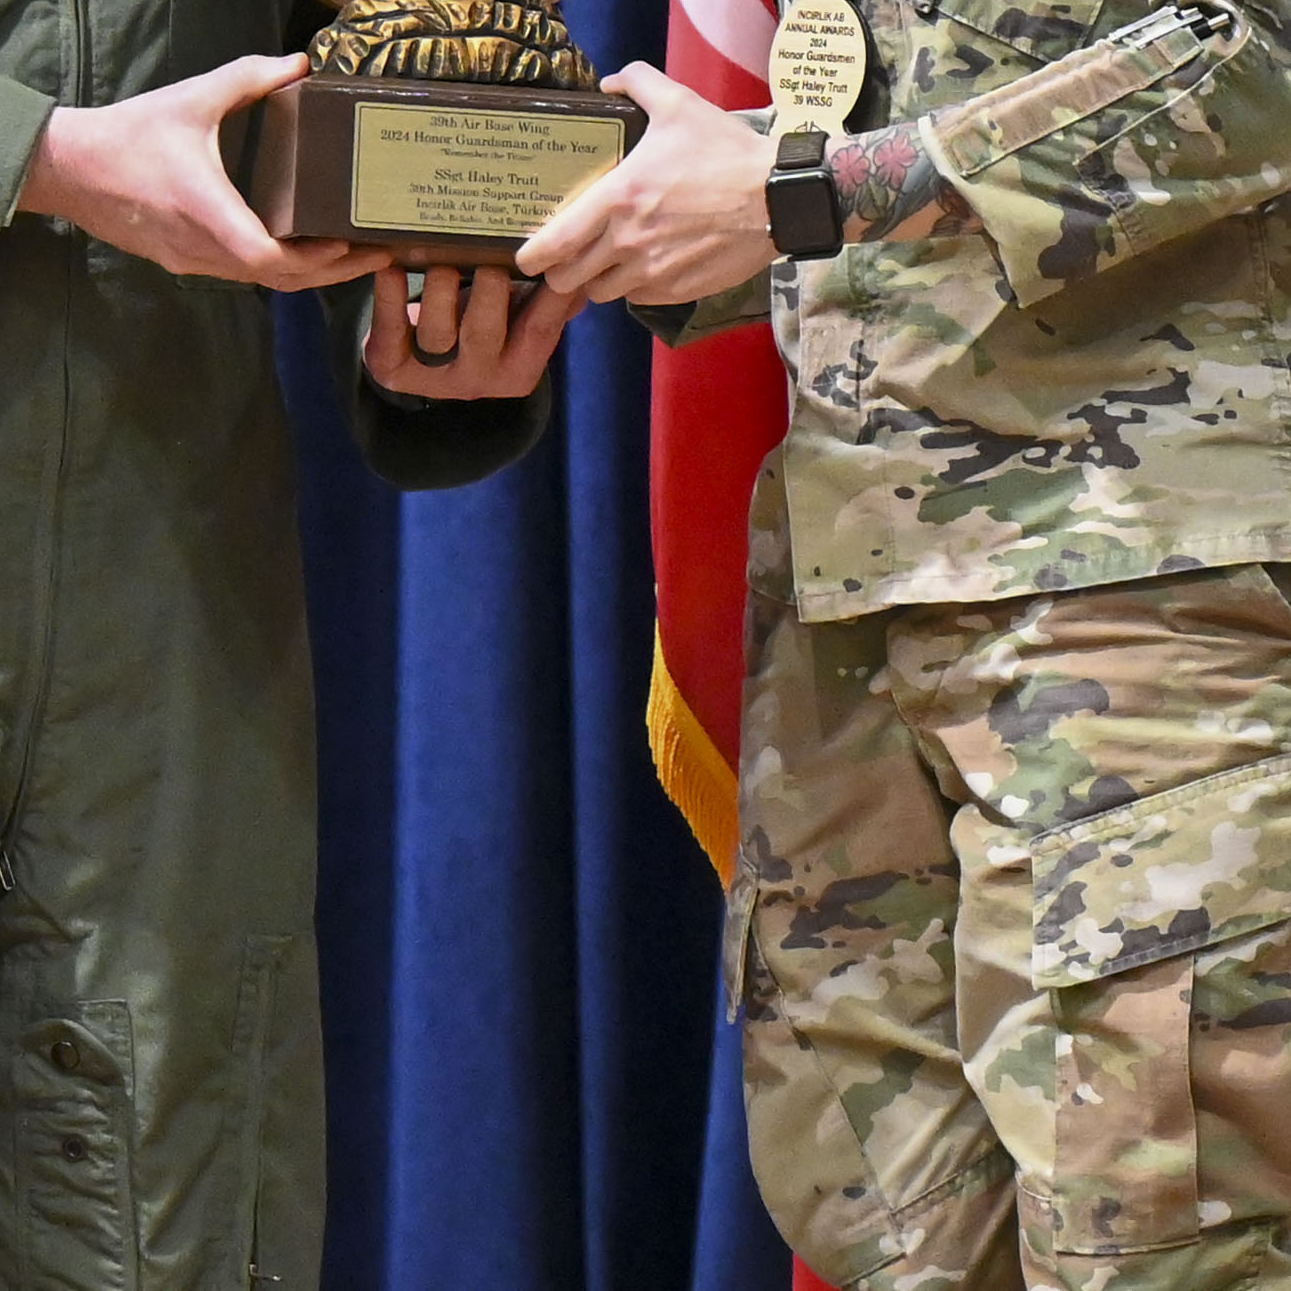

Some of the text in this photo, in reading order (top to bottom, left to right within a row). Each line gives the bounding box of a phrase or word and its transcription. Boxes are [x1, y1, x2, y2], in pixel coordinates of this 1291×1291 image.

[833, 12, 845, 22] AB
[785, 23, 855, 37] ANNUAL AWARDS
[809, 38, 827, 48] 2024
[778, 49, 804, 59] Honor
[792, 65, 838, 78] of the Year
[779, 78, 848, 94] SSgt Haley Trutt
[793, 95, 804, 105] 39
[429, 116, 550, 135] 39th Air Base Wing
[380, 129, 597, 154] 2024 Honor Guardsman of the Year
[434, 169, 539, 186] SSgt Haley Trutt
[482, 187, 526, 202] Support
[529, 190, 564, 204] Group
[459, 200, 477, 212] Air
